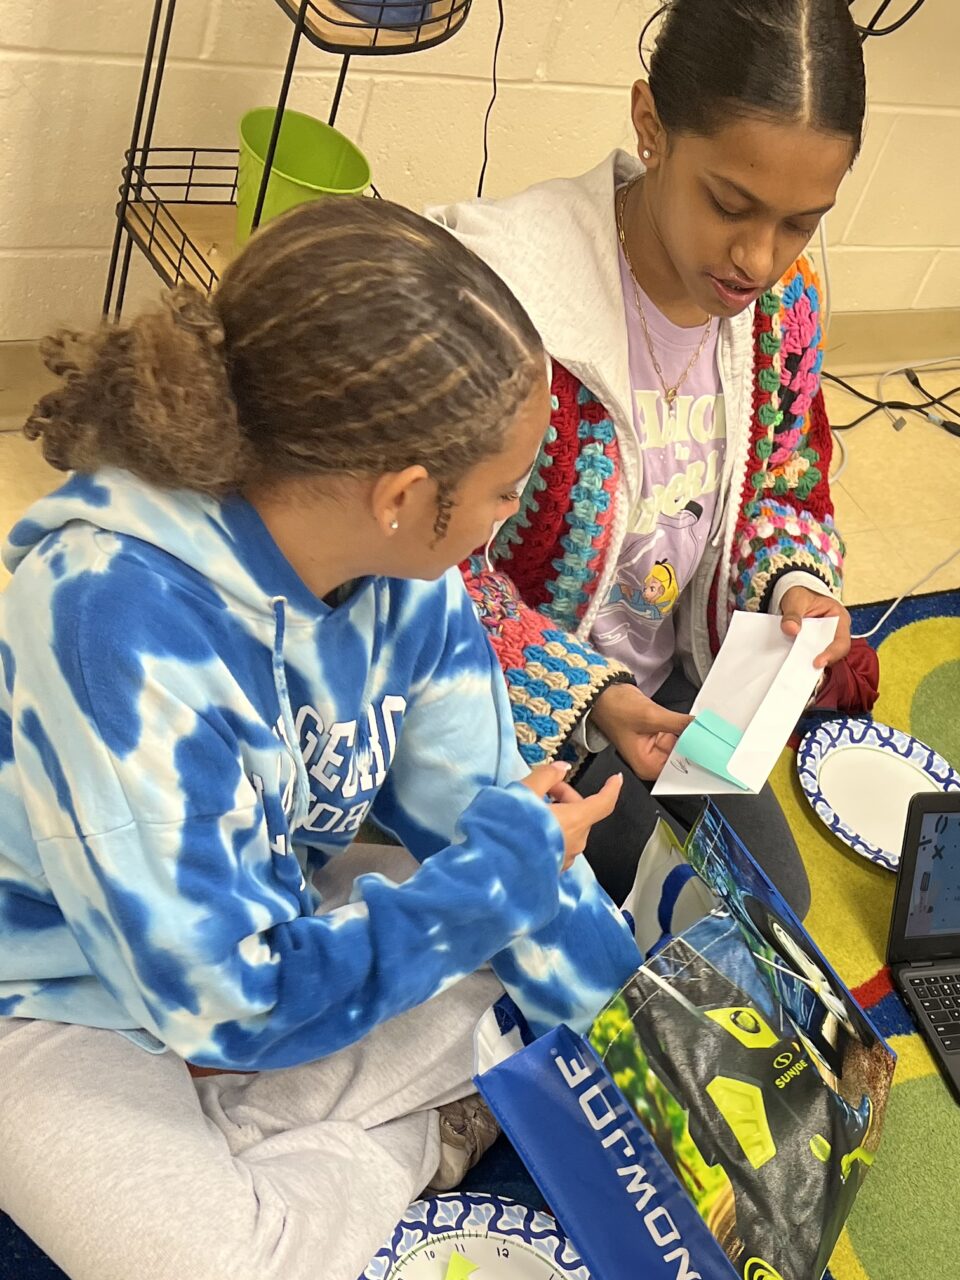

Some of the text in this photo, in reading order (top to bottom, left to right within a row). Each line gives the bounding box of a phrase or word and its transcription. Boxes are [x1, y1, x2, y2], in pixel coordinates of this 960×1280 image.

[774, 1058, 808, 1089] SUNJOE
[424, 1249, 436, 1261] 10
[496, 1246, 510, 1259] 12
